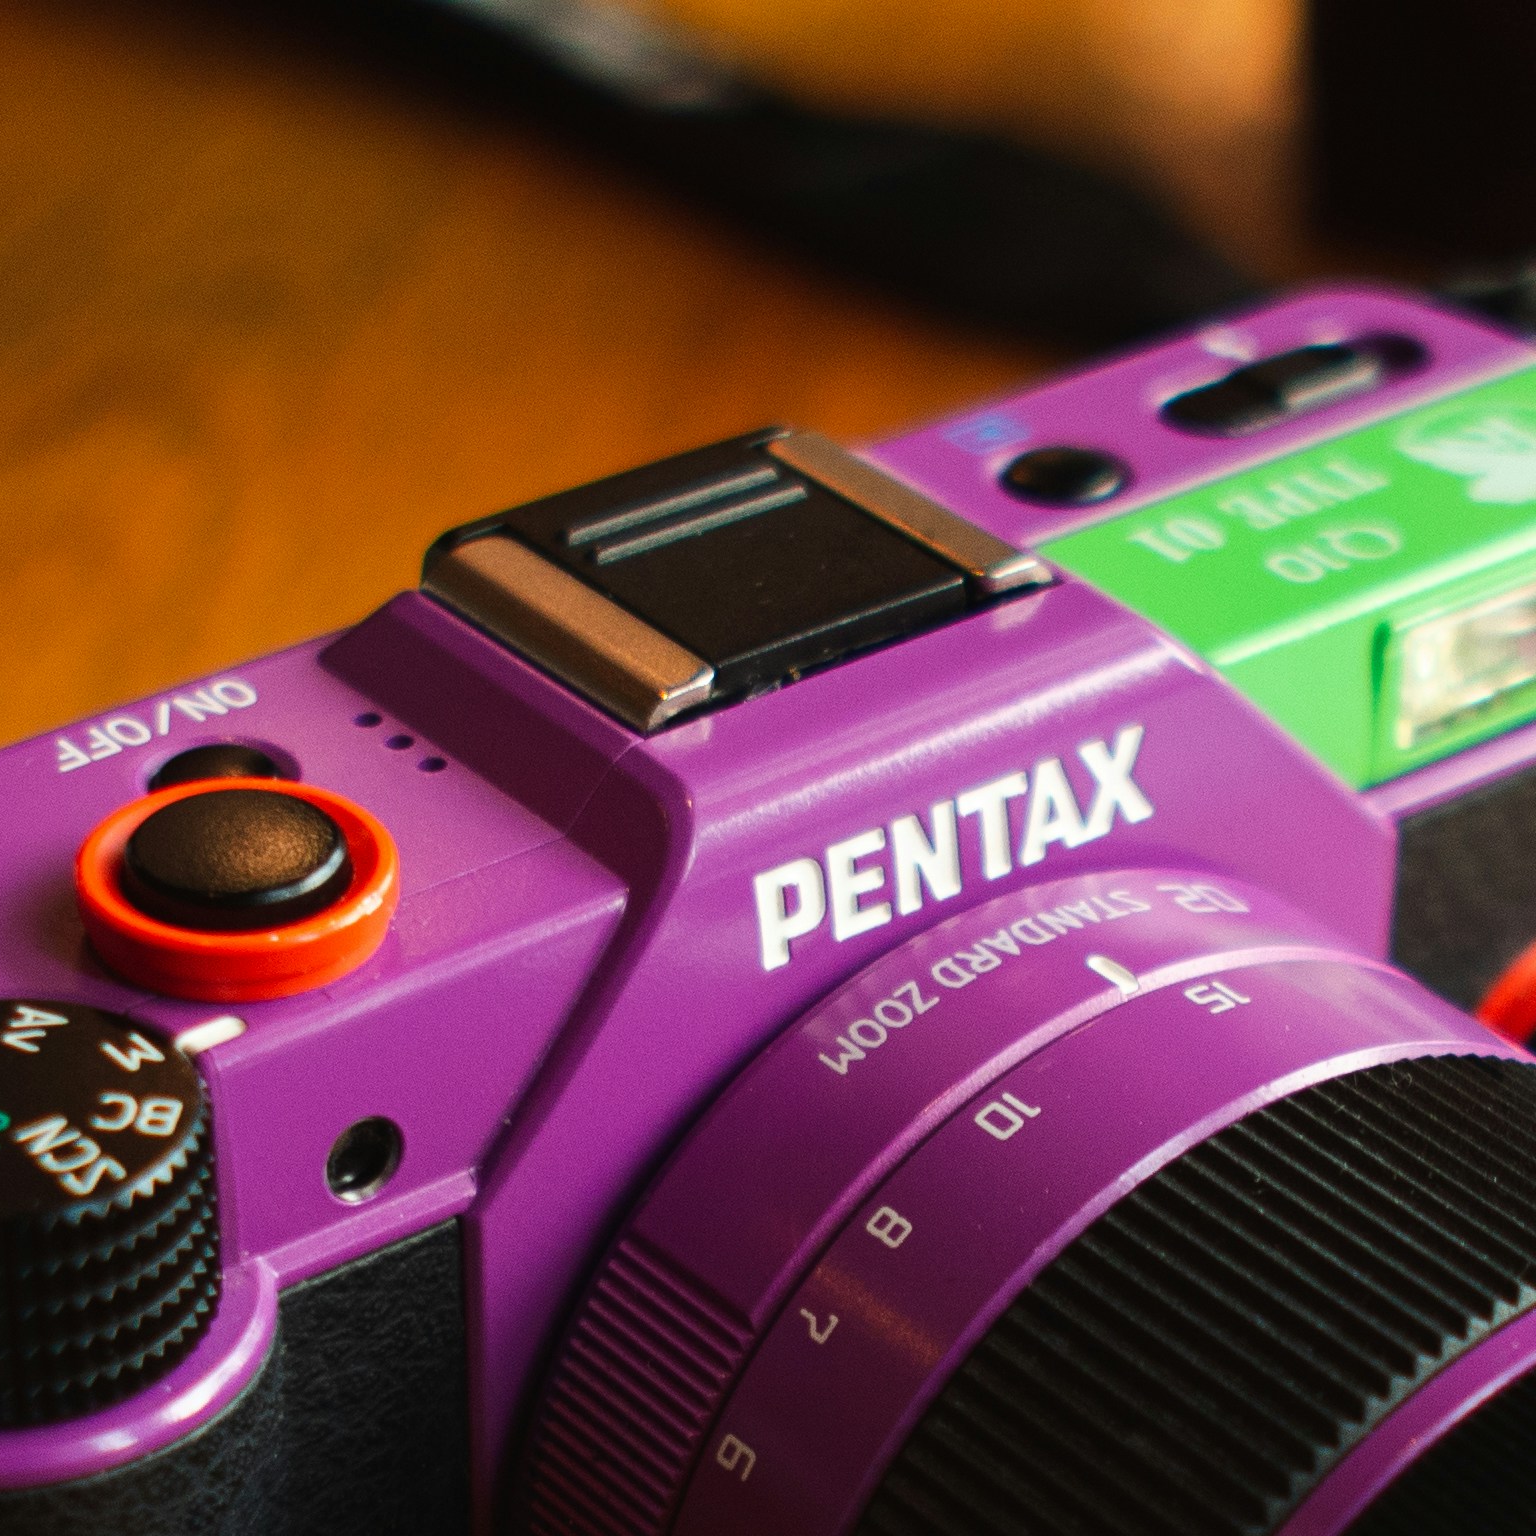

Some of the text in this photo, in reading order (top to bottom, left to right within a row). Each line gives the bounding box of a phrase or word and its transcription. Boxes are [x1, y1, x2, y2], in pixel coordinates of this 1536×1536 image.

[57, 676, 259, 774] ON/OFF
[752, 723, 1154, 972] PENTAX
[930, 888, 1152, 991] STANDARD
[99, 1031, 166, 1073] M
[817, 979, 941, 1077] ZOOM
[13, 1114, 129, 1197] SCN
[91, 1092, 185, 1138] BC
[715, 1432, 757, 1483] 6
[799, 1307, 839, 1345] 7
[865, 1205, 914, 1250] 8
[973, 1092, 1042, 1142] 10
[1182, 980, 1253, 1015] 15
